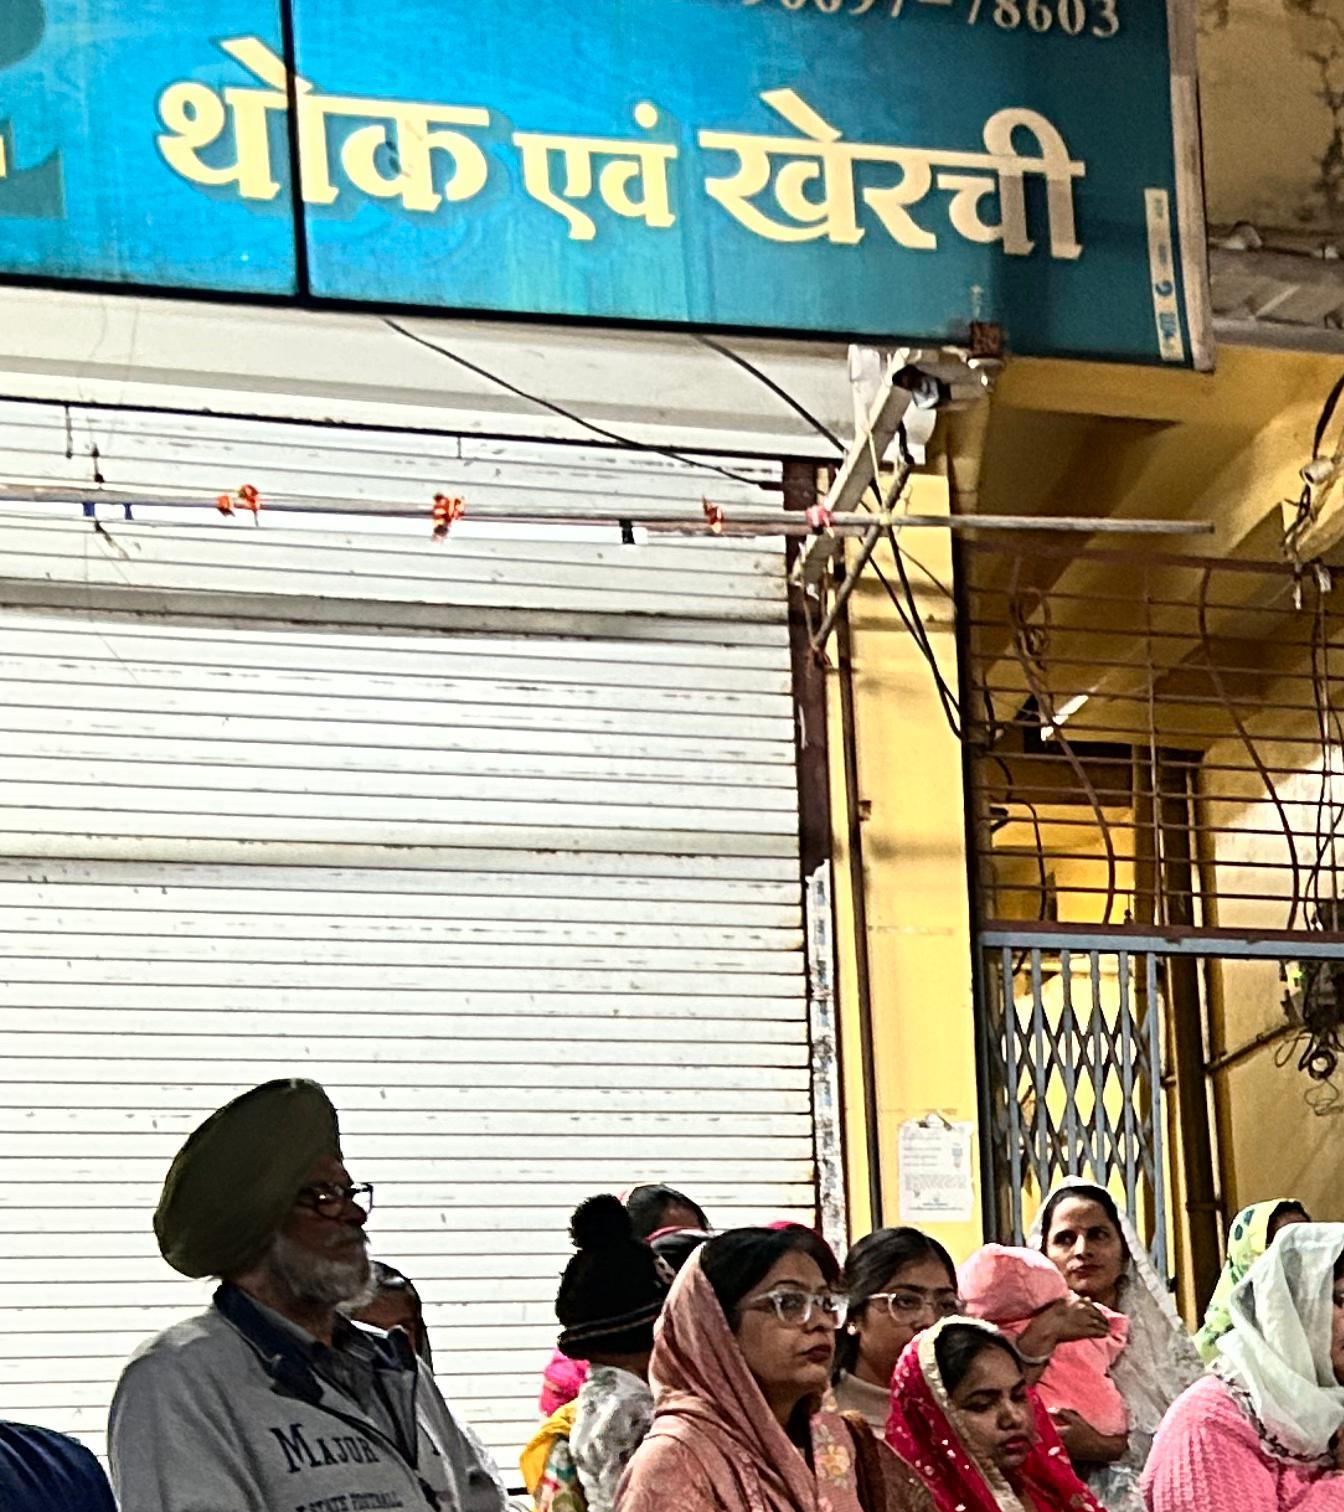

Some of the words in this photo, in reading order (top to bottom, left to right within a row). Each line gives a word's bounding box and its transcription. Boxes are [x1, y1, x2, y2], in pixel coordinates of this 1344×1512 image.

[156, 36, 490, 213] थोक
[514, 102, 678, 241] एवं
[699, 87, 1086, 261] खेरची
